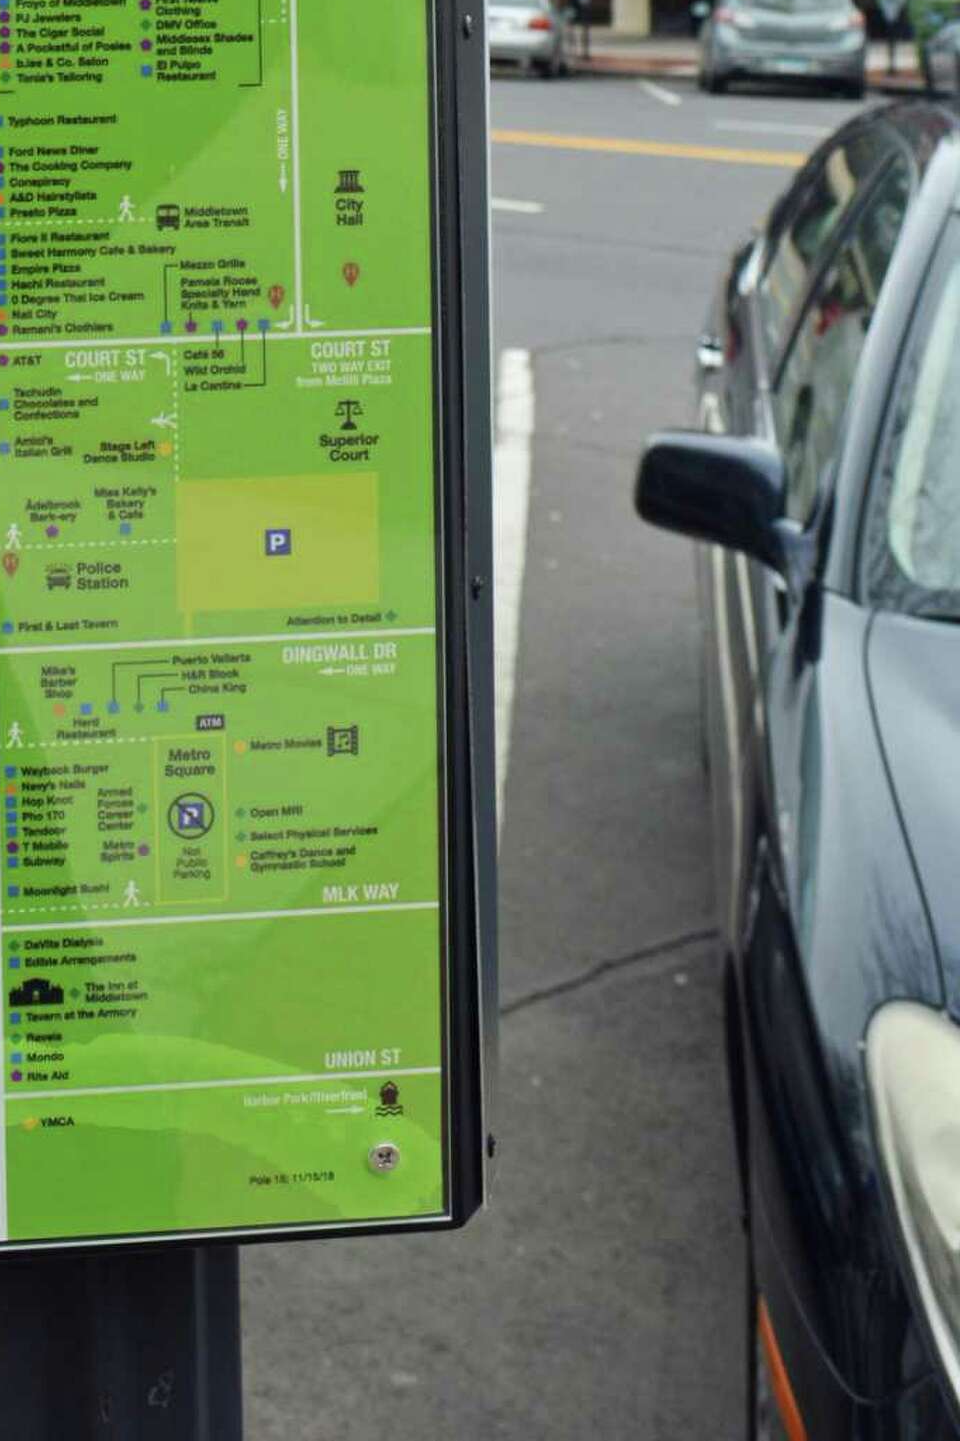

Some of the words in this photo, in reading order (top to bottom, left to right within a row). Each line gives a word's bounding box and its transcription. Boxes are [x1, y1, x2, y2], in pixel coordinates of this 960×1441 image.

[32, 161, 75, 174] Cooking
[79, 159, 132, 172] Company
[335, 199, 363, 215] City
[336, 213, 363, 226] Hall
[311, 342, 365, 358] COURT
[370, 341, 391, 357] ST
[65, 350, 121, 368] COURT
[126, 350, 147, 366] ST
[319, 434, 379, 449] Superior
[329, 448, 369, 461] Court
[77, 562, 121, 574] Police
[77, 577, 128, 590] Station
[283, 644, 368, 662] DINGWALL
[373, 642, 396, 659] DR
[199, 716, 222, 728] ATM
[168, 748, 210, 761] Metro
[165, 763, 215, 777] Square
[323, 886, 358, 902] MLK
[363, 884, 399, 901] WAY
[325, 1050, 376, 1068] UNION
[381, 1049, 401, 1065] ST
[41, 1117, 74, 1127] YMCA
